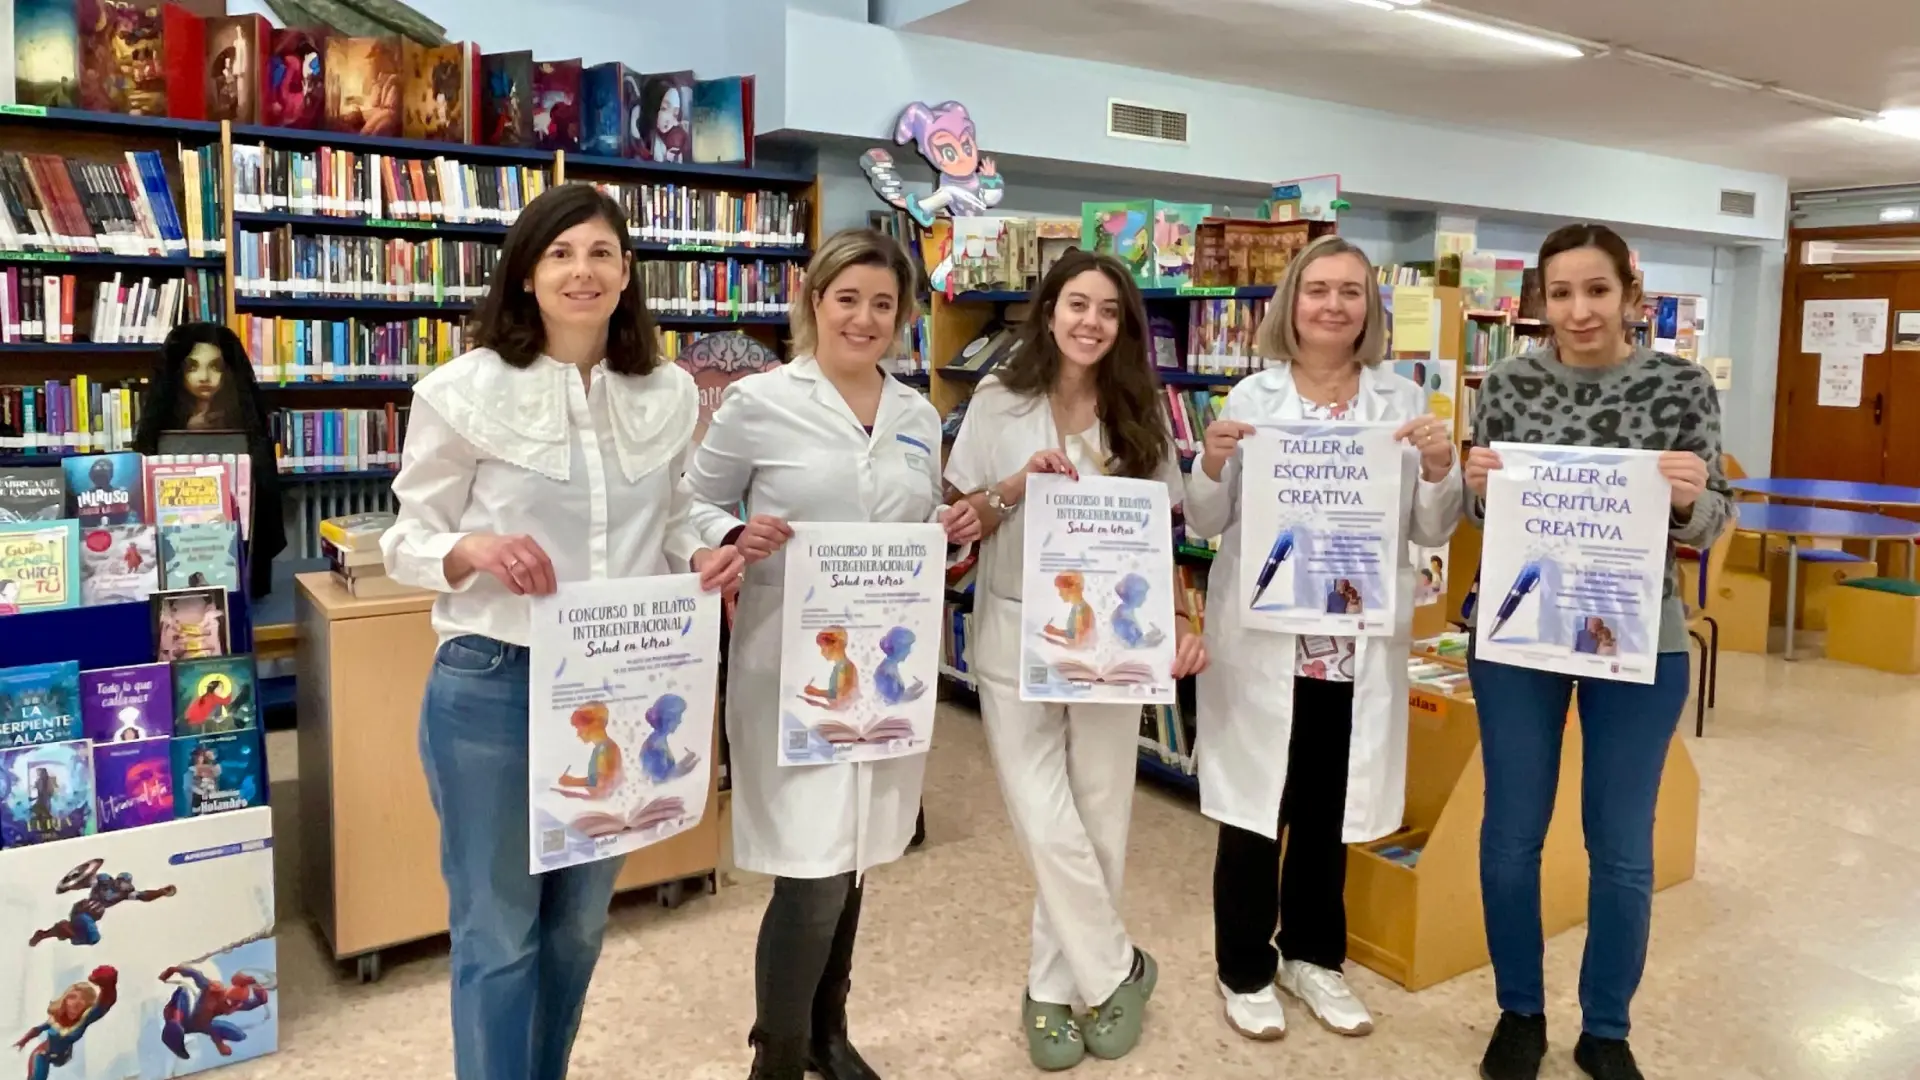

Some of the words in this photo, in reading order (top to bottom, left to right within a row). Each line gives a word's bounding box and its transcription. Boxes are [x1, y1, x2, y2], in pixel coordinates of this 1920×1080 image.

[1280, 439, 1341, 454] TALLER
[1346, 440, 1364, 455] de
[1273, 465, 1369, 480] ESCRITURA
[1530, 465, 1600, 484] TALLER
[1606, 469, 1628, 487] de
[77, 489, 129, 508] INTRUSO
[1053, 494, 1100, 506] CONCURSO
[1104, 495, 1115, 507] DE
[1118, 497, 1152, 509] RELATOS
[1278, 489, 1363, 504] CREATIVA
[1521, 492, 1632, 514] ESCRITURA
[1056, 508, 1142, 522] INTERGENERACIONAL
[1067, 521, 1094, 534] Salud
[1097, 526, 1108, 534] en
[1110, 524, 1135, 535] letras
[1525, 518, 1623, 540] CREATIVA
[817, 545, 868, 557] CONCURSO
[872, 545, 884, 557] DE
[888, 545, 927, 557] RELATOS
[820, 560, 914, 572] INTERGENERACIONAL
[830, 574, 860, 588] Salud
[863, 578, 874, 586] en
[877, 575, 905, 587] letras
[558, 609, 563, 624] I
[568, 604, 628, 623] CONCURSO
[633, 602, 647, 617] DE
[652, 598, 696, 614] RELATOS
[573, 616, 683, 640] INTERGENERACIONAL
[585, 641, 620, 657] Salud
[624, 642, 637, 652] en
[641, 637, 673, 651] letras
[22, 705, 42, 718] LA
[0, 714, 71, 735] ERPIENTE
[14, 729, 54, 746] ALAS
